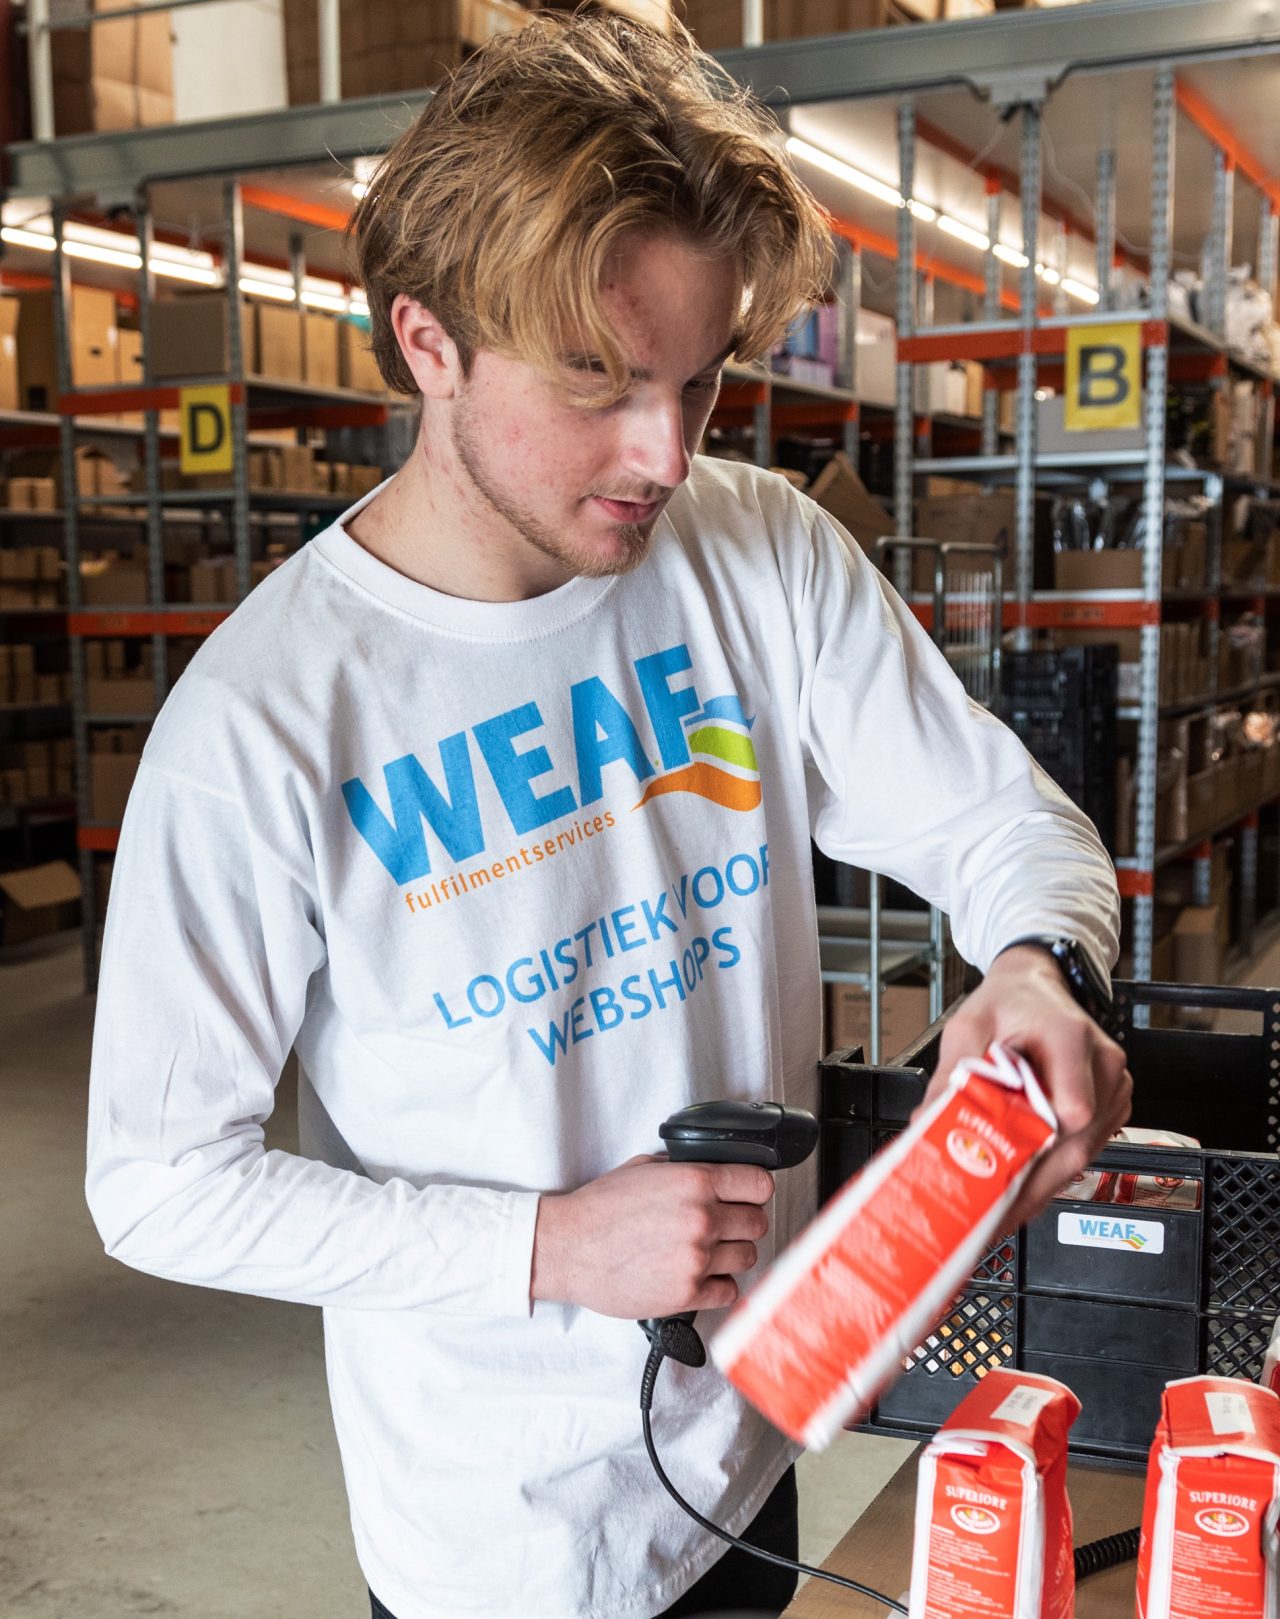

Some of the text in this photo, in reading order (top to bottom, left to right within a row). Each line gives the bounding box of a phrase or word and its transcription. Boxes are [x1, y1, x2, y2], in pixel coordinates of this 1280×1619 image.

[1078, 346, 1128, 407] B
[189, 403, 225, 454] D
[341, 643, 701, 887] WEAF
[405, 808, 616, 913] fulfilmentservices
[433, 891, 679, 1030] LOGISTIEK
[528, 927, 741, 1066] WEBSHOPS
[1079, 1218, 1136, 1240] WEAF
[945, 1484, 1008, 1511] SUPERIORE
[1189, 1490, 1258, 1512] SUPERIORE
